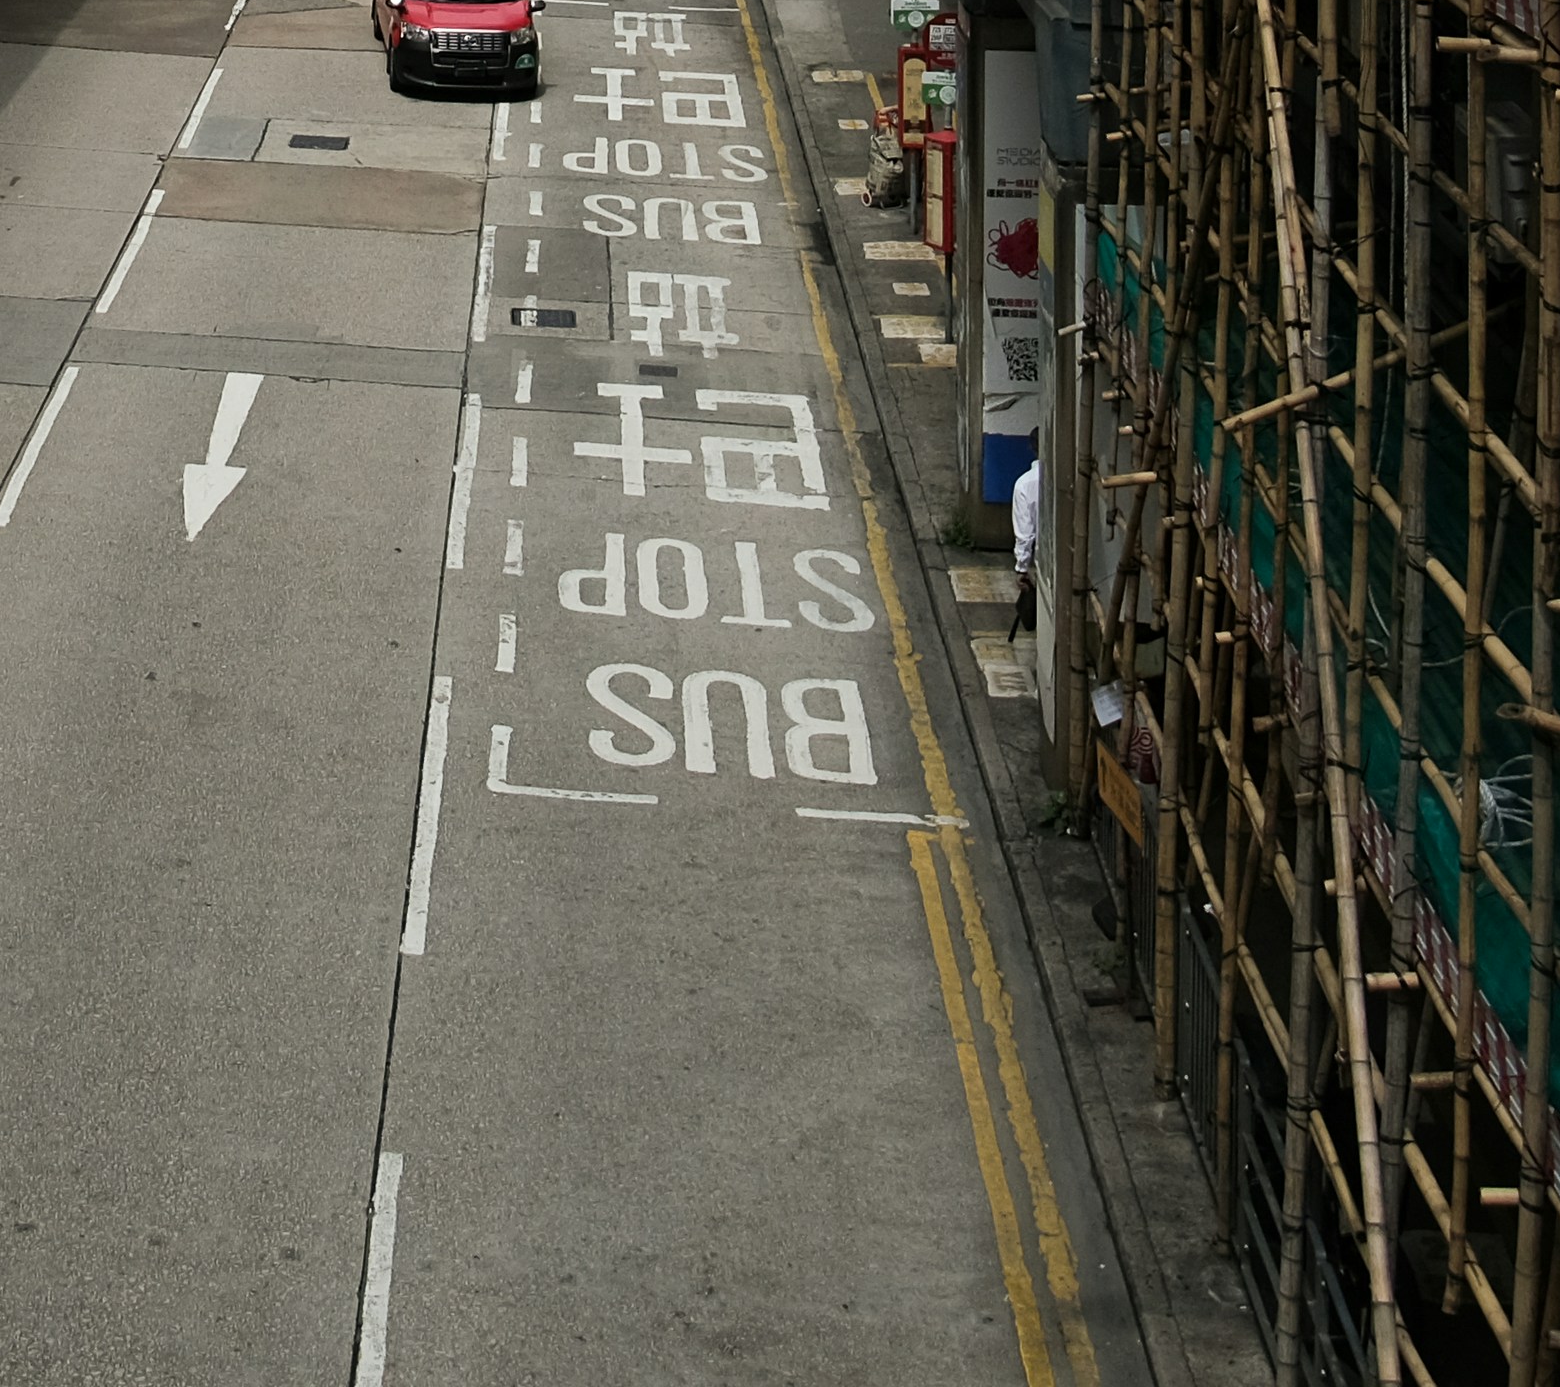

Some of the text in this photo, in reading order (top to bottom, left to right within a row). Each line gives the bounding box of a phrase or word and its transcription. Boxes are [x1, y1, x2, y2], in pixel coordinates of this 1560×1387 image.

[573, 66, 747, 128] 巴士
[562, 136, 769, 183] STOP
[582, 193, 762, 245] BUS
[627, 271, 740, 359] 站
[573, 382, 831, 511] 巴士
[557, 532, 876, 633] STOP
[586, 662, 879, 786] BUS
